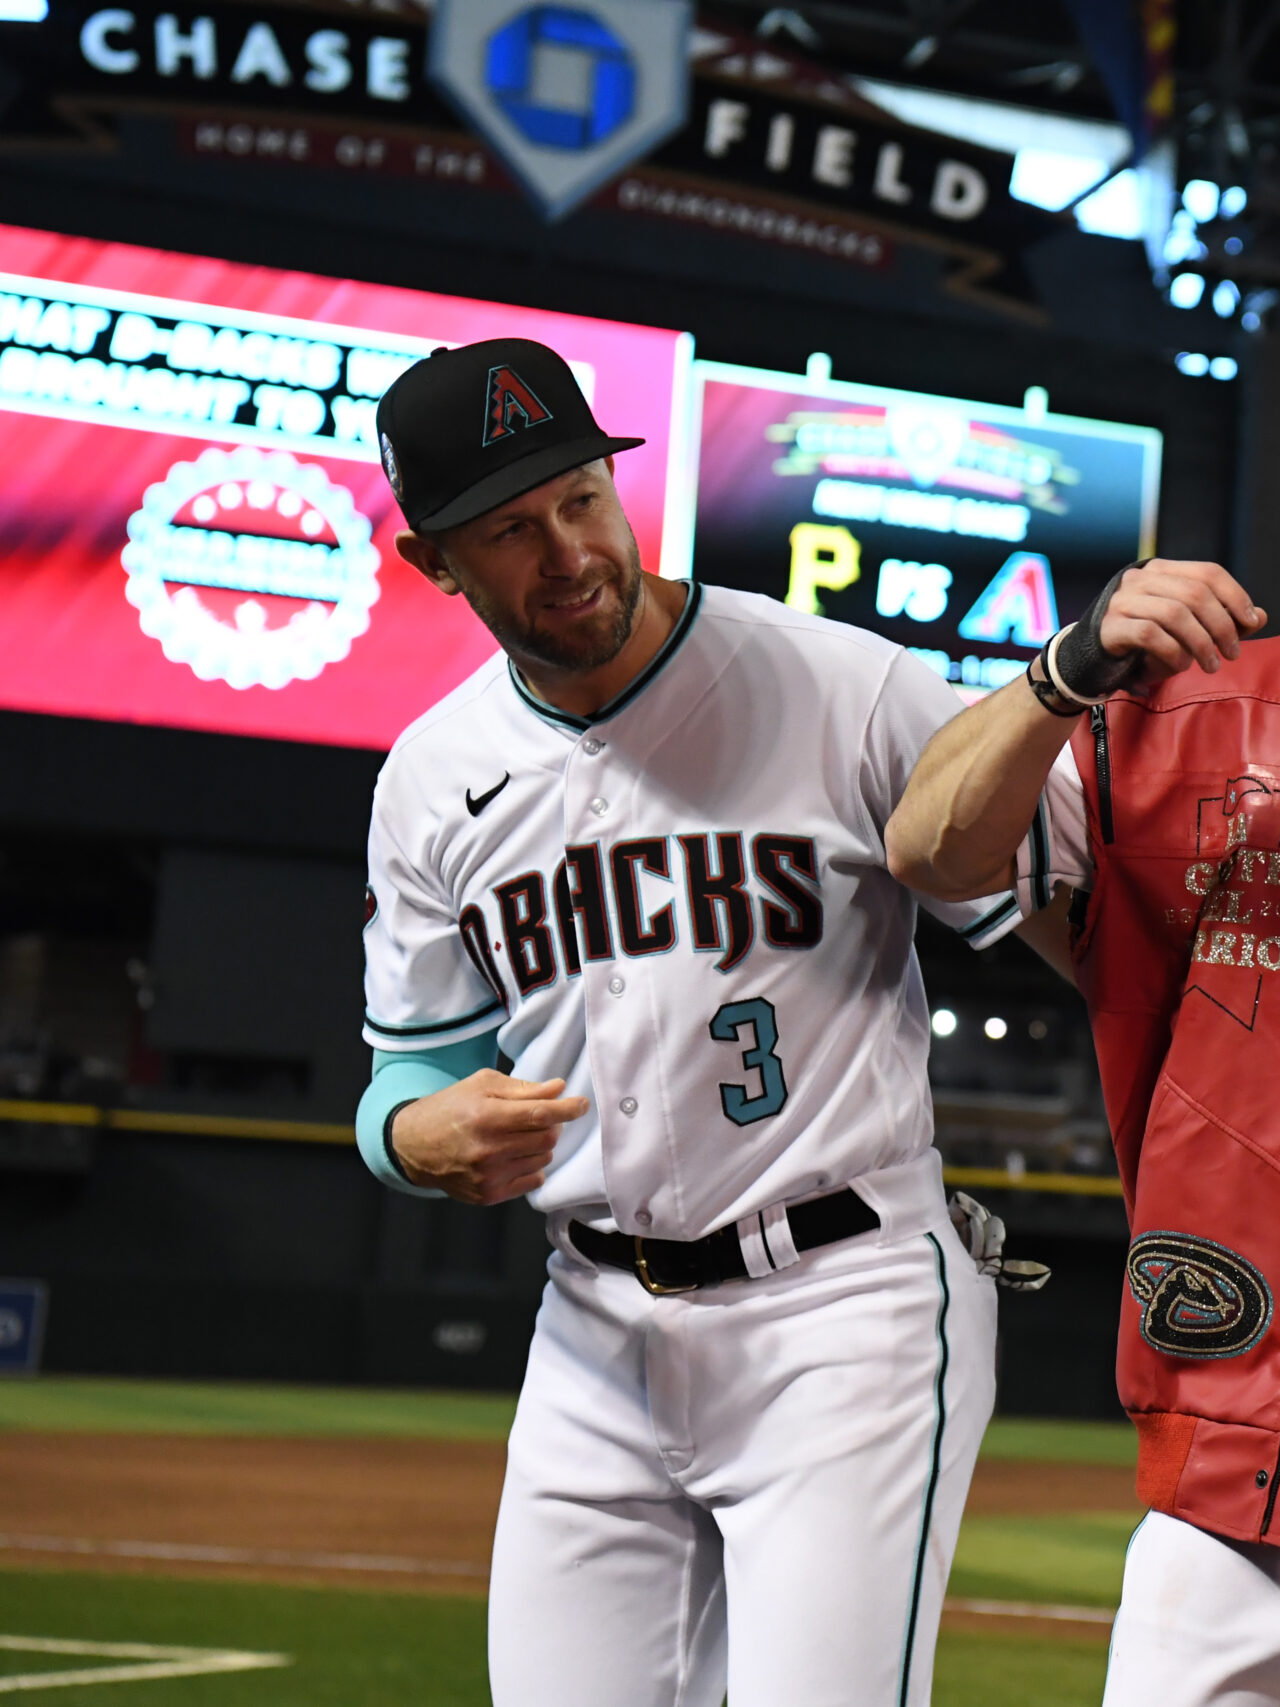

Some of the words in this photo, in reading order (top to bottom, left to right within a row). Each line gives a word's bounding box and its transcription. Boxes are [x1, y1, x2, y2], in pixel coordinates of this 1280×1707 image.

[80, 11, 411, 101] CHASE
[703, 98, 989, 220] FIELD
[195, 122, 309, 161] HOME
[335, 134, 387, 169] OF
[414, 143, 487, 184] THE
[617, 178, 884, 265] DIAMONDBACKS
[481, 363, 554, 448] A
[785, 522, 861, 616] P
[957, 550, 1060, 648] A
[708, 995, 789, 1128] 3
